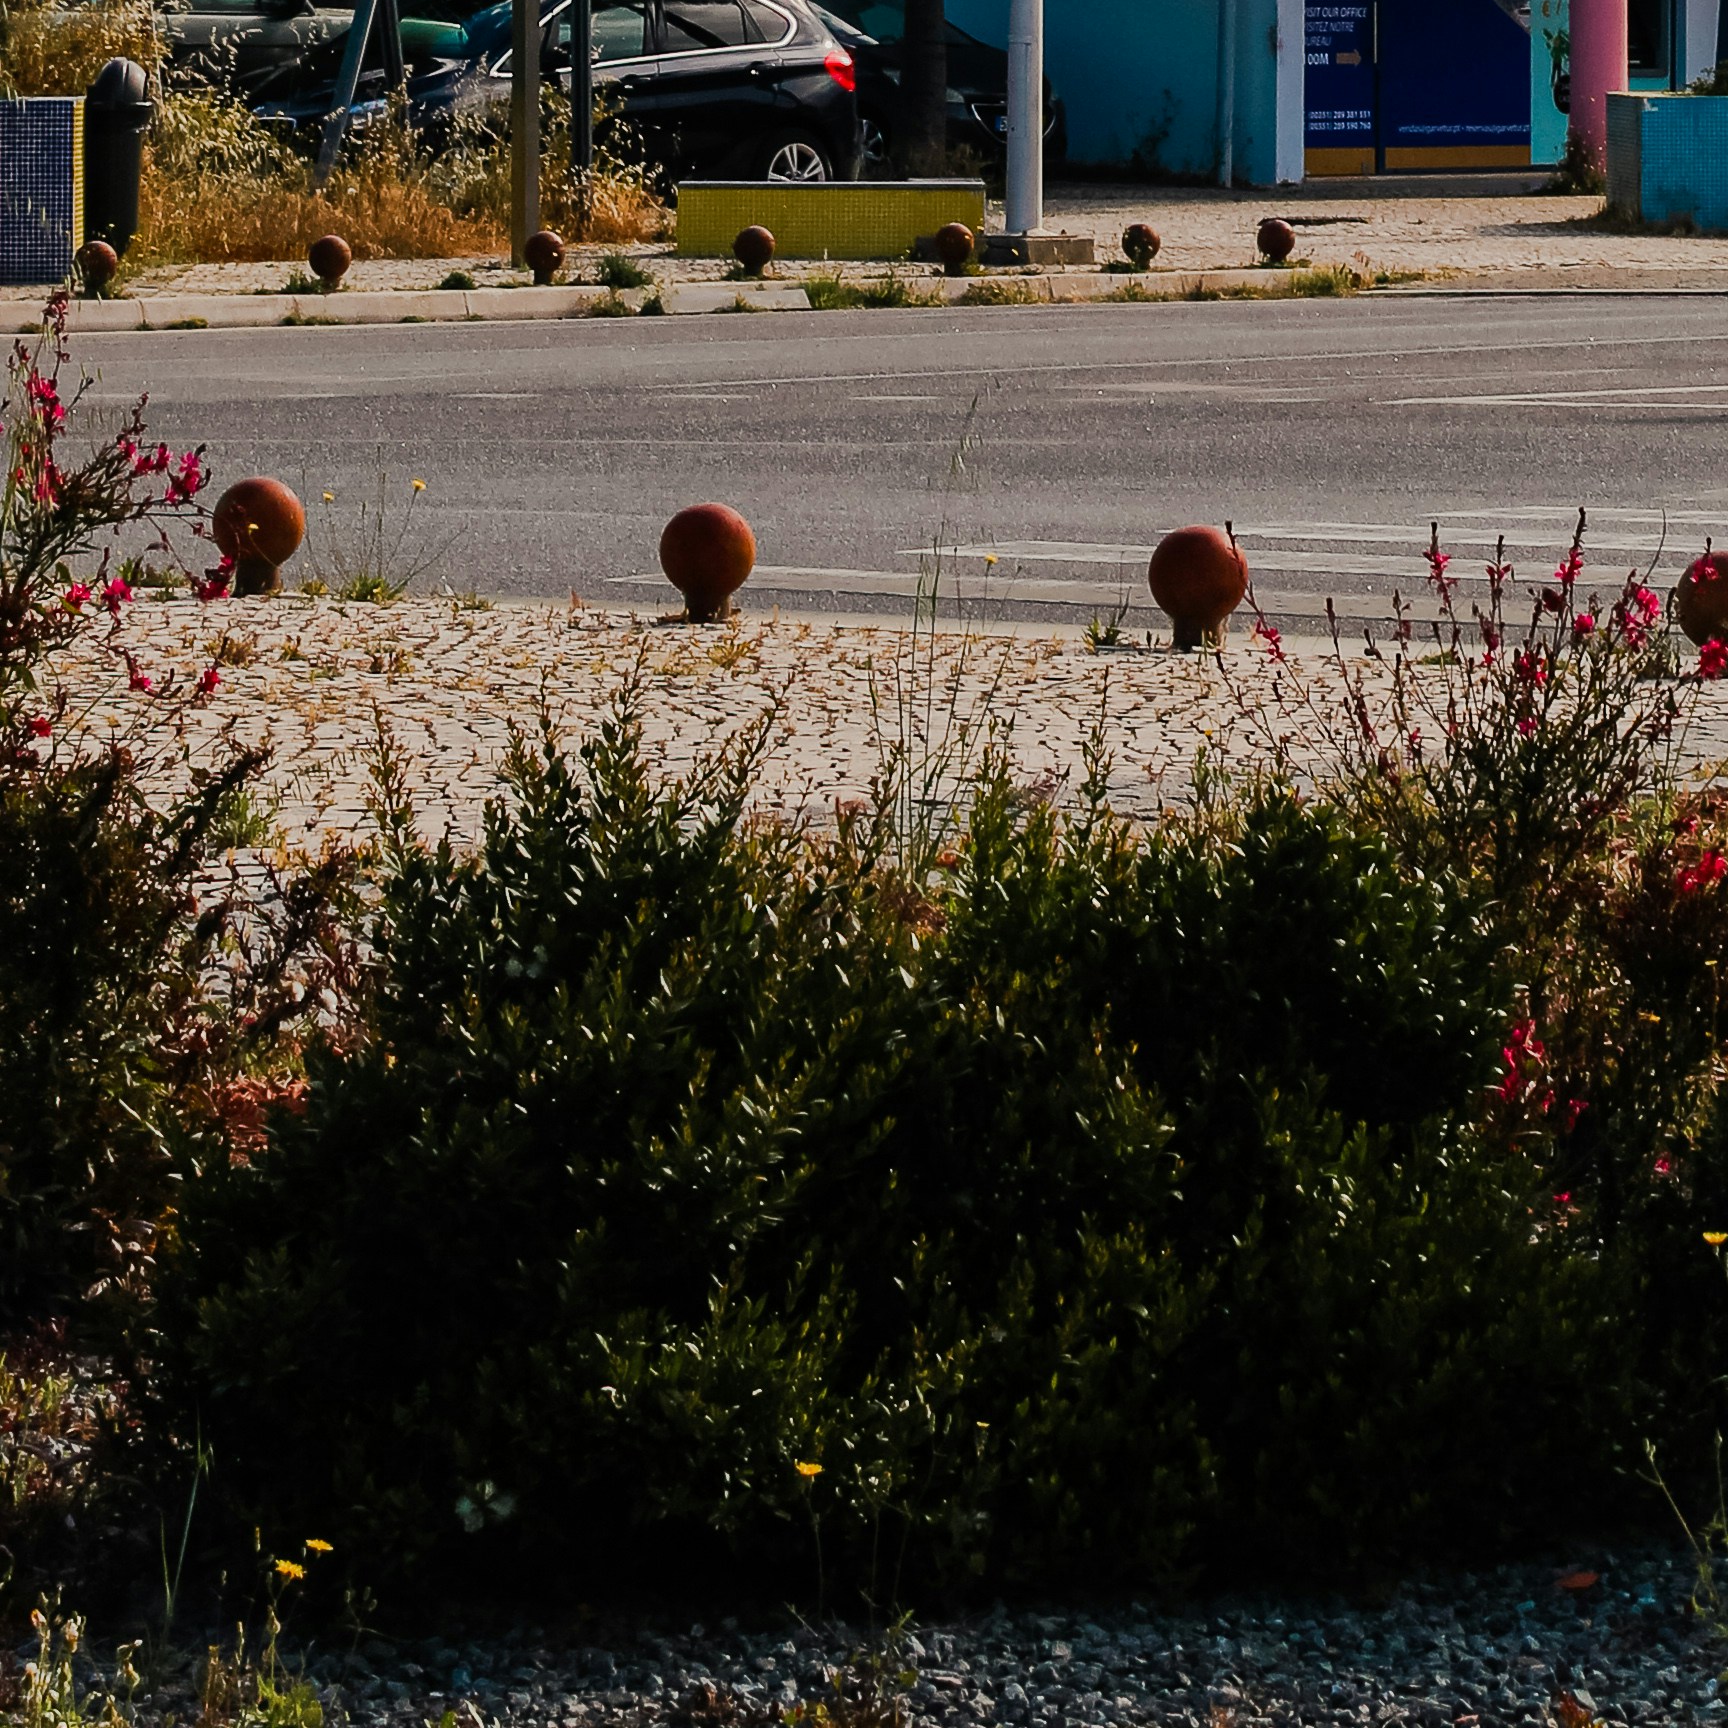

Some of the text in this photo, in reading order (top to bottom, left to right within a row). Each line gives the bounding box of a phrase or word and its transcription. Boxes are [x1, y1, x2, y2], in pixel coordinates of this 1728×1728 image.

[1322, 7, 1339, 18] OUR
[1340, 7, 1368, 18] OFFICE
[1330, 21, 1355, 33] NOTRE
